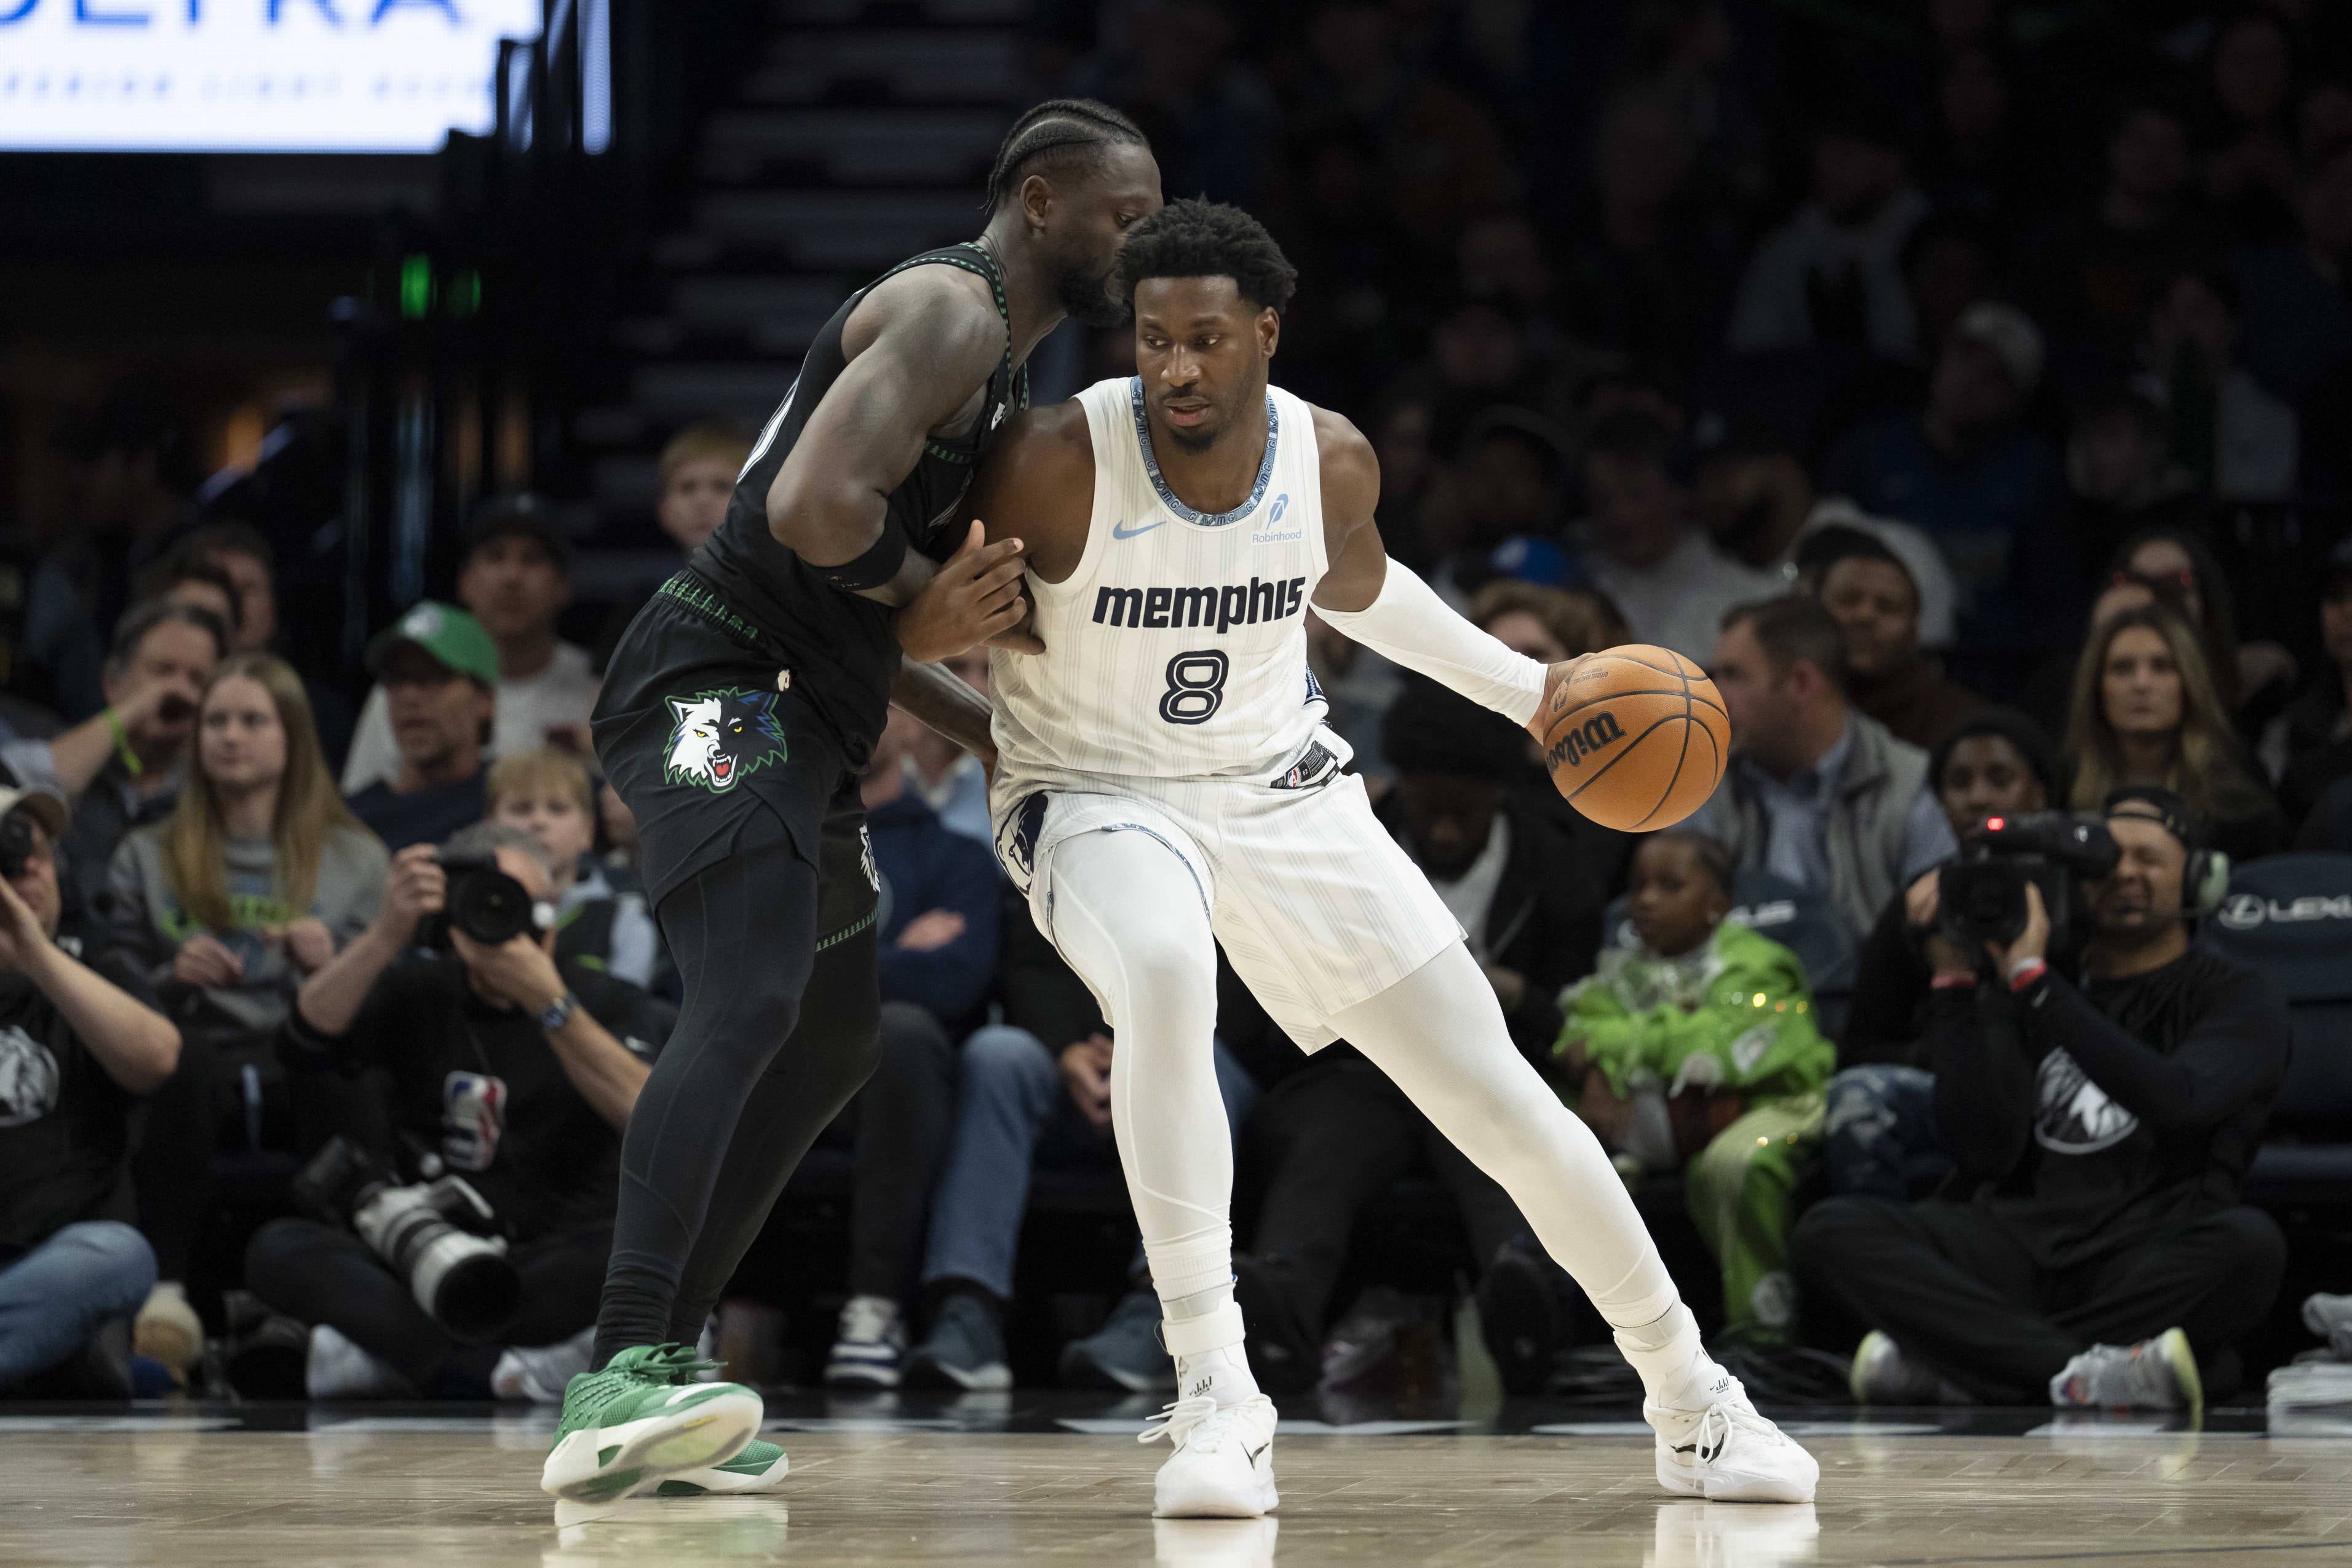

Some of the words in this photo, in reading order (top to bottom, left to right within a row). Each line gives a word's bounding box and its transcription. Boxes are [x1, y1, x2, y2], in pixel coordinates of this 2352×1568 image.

[1252, 529, 1301, 543] Robinhood
[1092, 576, 1306, 634] memphis
[1159, 649, 1230, 725] 8
[1546, 710, 1627, 777] Wilso
